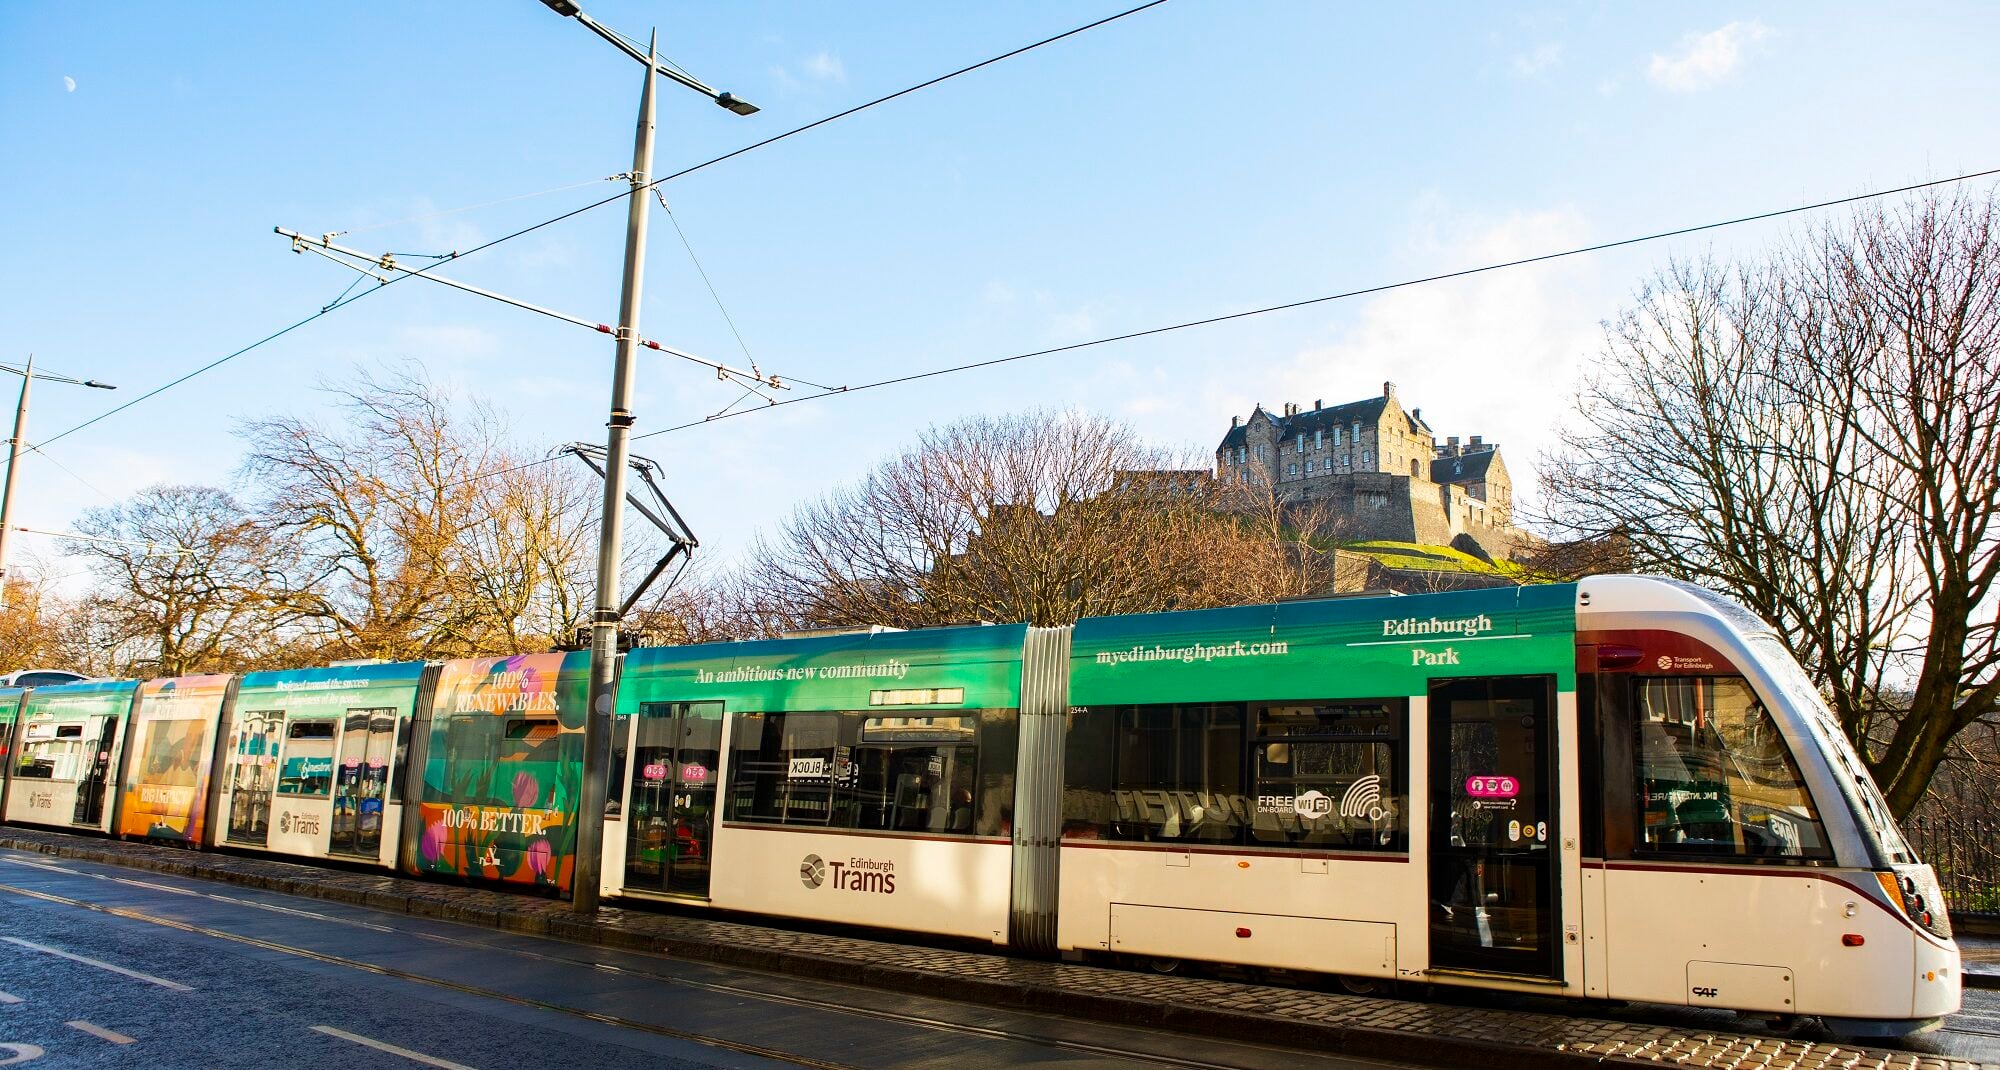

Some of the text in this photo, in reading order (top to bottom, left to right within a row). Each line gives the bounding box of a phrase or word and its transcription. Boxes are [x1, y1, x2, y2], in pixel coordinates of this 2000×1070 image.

[1382, 614, 1492, 637] Edinburgh
[1095, 640, 1288, 666] myedinburghpark.com
[1411, 647, 1460, 666] Park
[1673, 656, 1702, 664] Transport
[491, 669, 529, 690] 100%
[694, 658, 910, 684] An ambitious new community
[276, 677, 370, 692] Designed around the success
[455, 690, 560, 713] RENEWABLES.
[1071, 706, 1089, 714] 254-A
[1257, 806, 1294, 814] ON-BOARD
[1258, 795, 1294, 807] FREE
[292, 815, 320, 835] Trams
[441, 808, 547, 836] 100% BETTER.
[850, 857, 894, 873] Edinburgh
[829, 861, 896, 895] Trams
[1691, 986, 1718, 998] CAF
